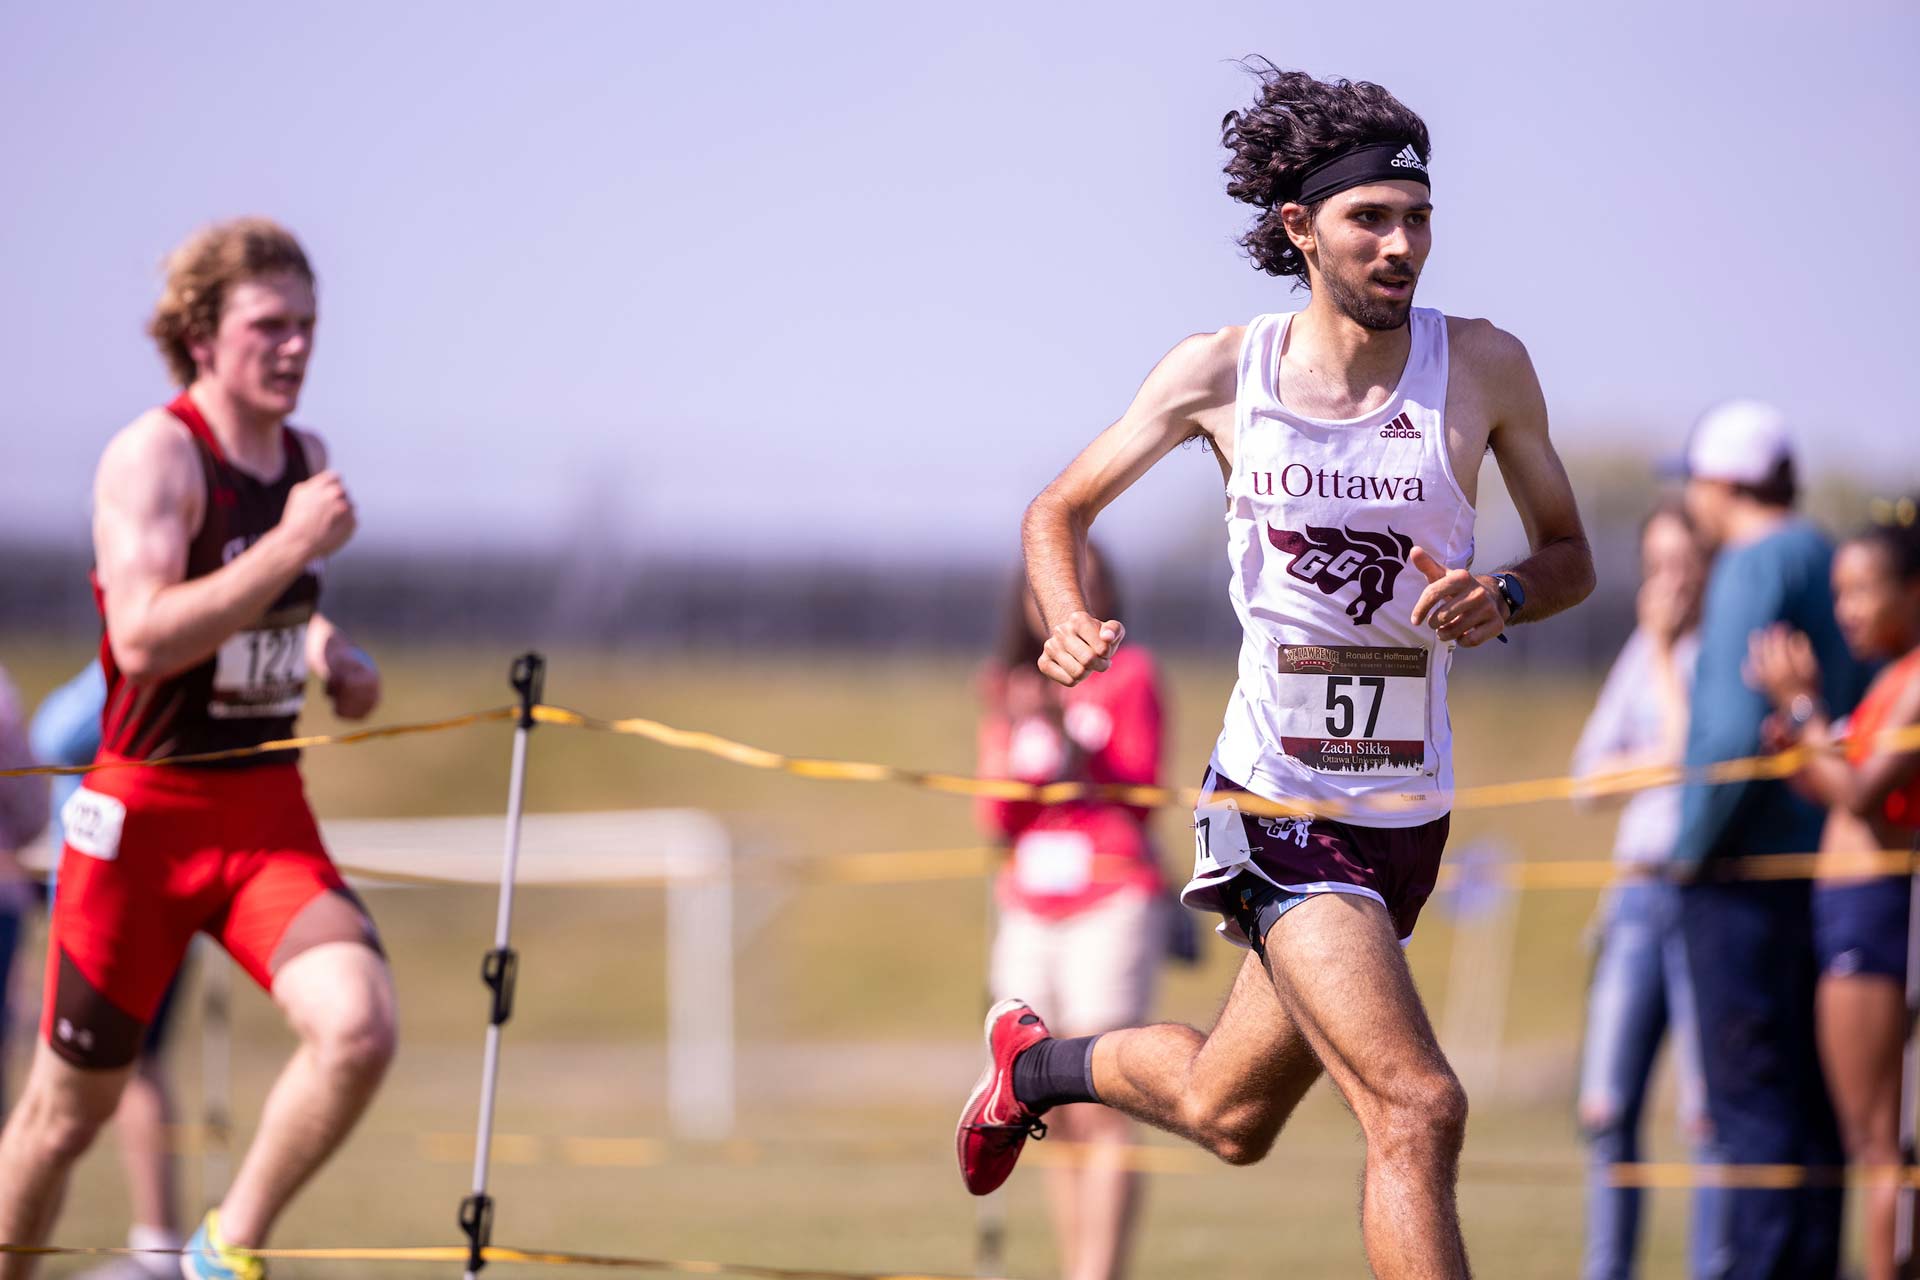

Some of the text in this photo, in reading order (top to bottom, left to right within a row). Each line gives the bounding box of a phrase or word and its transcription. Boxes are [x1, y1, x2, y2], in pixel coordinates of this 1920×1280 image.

[1380, 428, 1422, 439] adidas
[1297, 646, 1340, 664] LAWRENCE
[1345, 651, 1373, 660] Ronald
[1383, 652, 1419, 661] Hoffmann
[1325, 676, 1385, 738] 57
[1320, 740, 1391, 755] Zach Sikka
[1322, 755, 1350, 764] Ottawa
